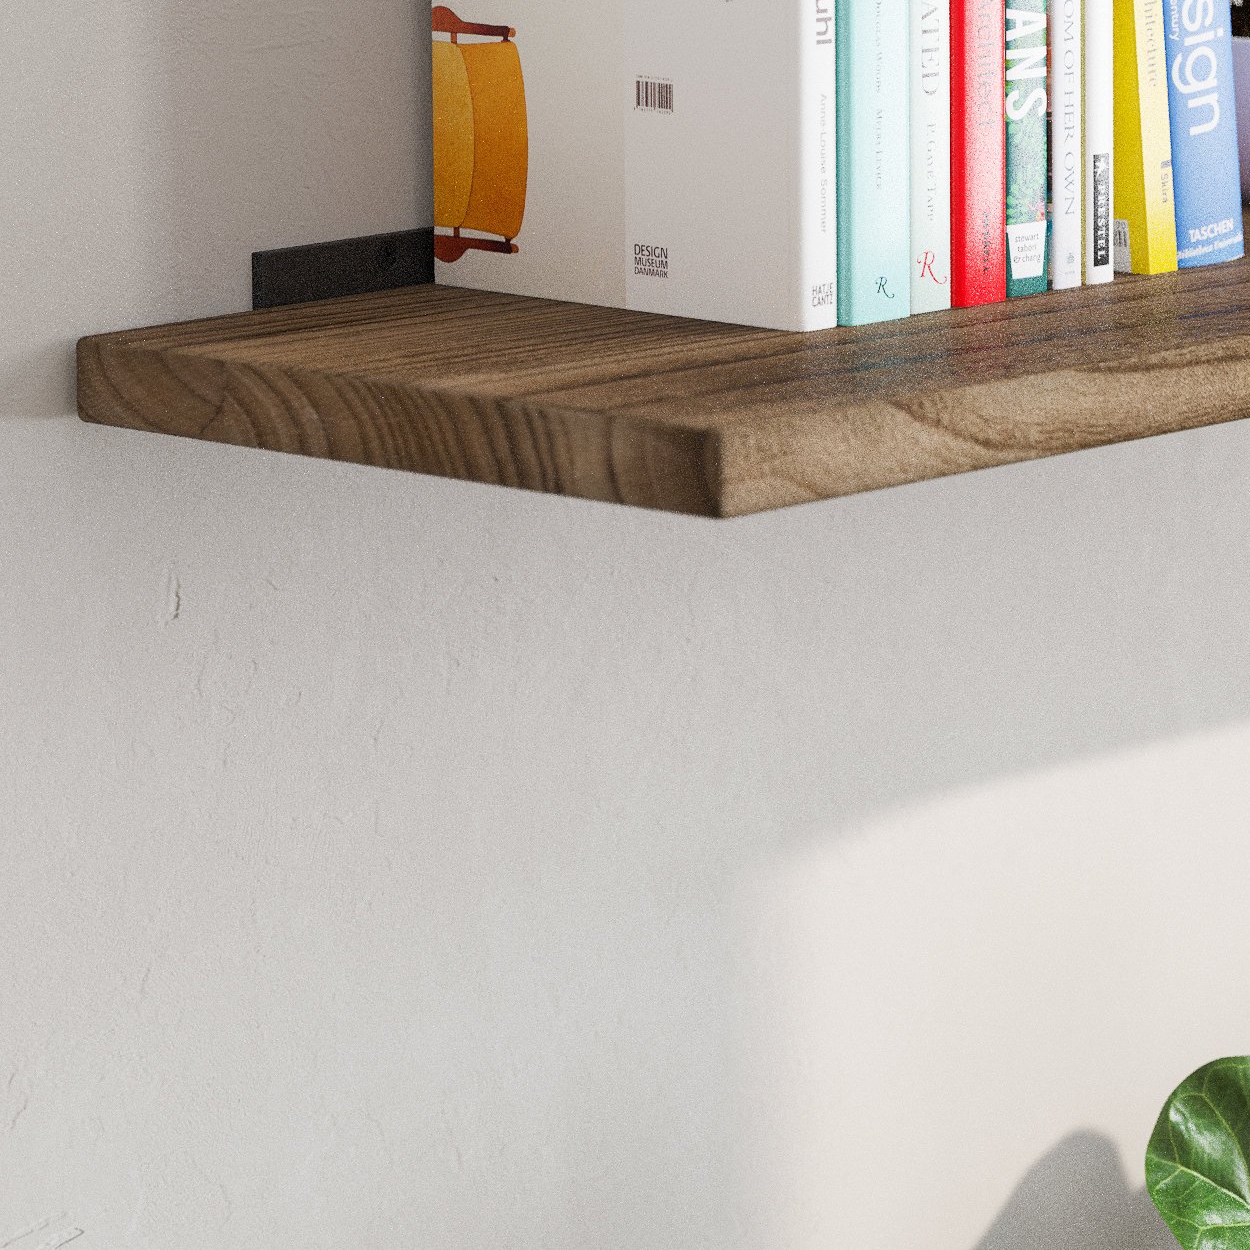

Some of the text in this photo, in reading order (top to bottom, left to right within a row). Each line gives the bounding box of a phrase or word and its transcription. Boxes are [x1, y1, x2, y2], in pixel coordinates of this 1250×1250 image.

[1063, 49, 1075, 84] OF
[1063, 90, 1076, 144] HER
[819, 93, 829, 234] Anne-Louise Sommer
[1064, 151, 1076, 216] OWN
[1160, 172, 1169, 204] Skira
[1098, 184, 1108, 260] PRESTEL
[1188, 217, 1234, 243] TASCHEN
[634, 243, 668, 260] DESIGN
[634, 256, 669, 270] MUSEUM
[916, 250, 948, 286] R
[634, 266, 669, 278] DANMARK
[874, 275, 896, 300] R
